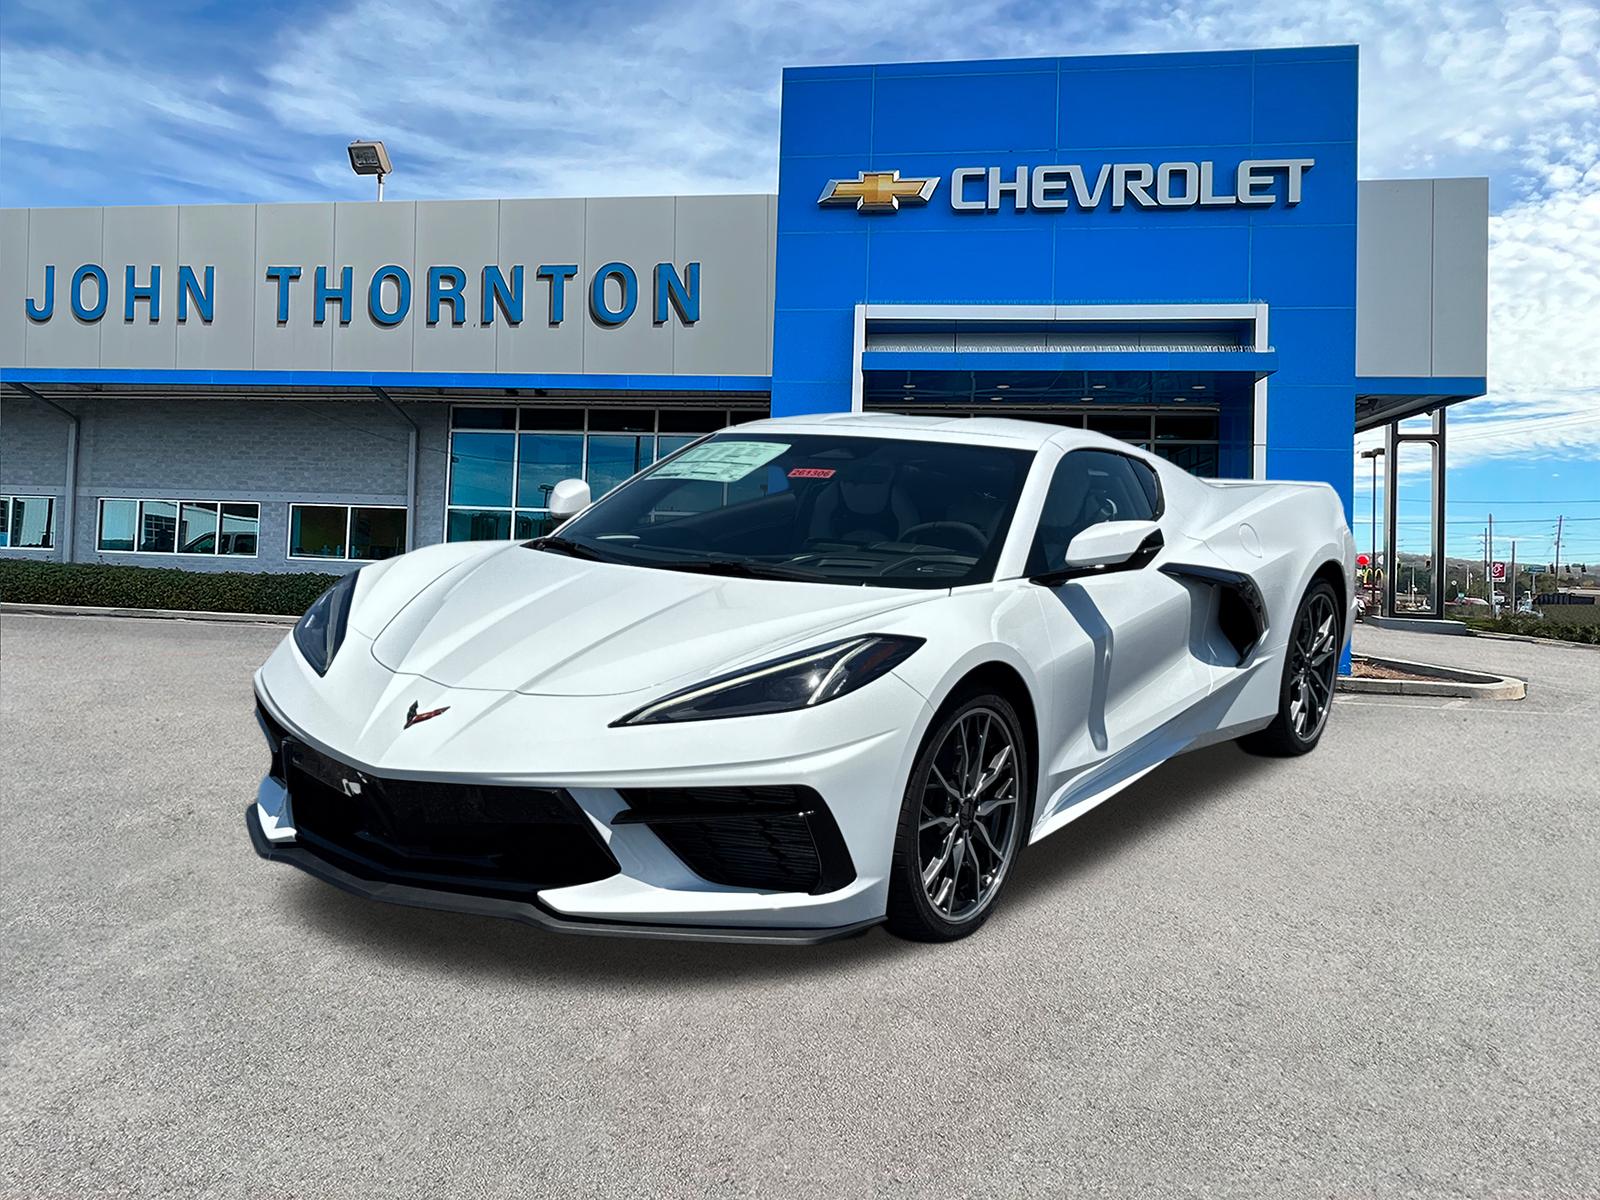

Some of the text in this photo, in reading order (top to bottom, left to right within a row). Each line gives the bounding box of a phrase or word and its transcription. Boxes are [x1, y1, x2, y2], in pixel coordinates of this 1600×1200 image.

[951, 158, 1315, 212] CHEVROLET
[25, 262, 702, 328] JOHN THORNTON
